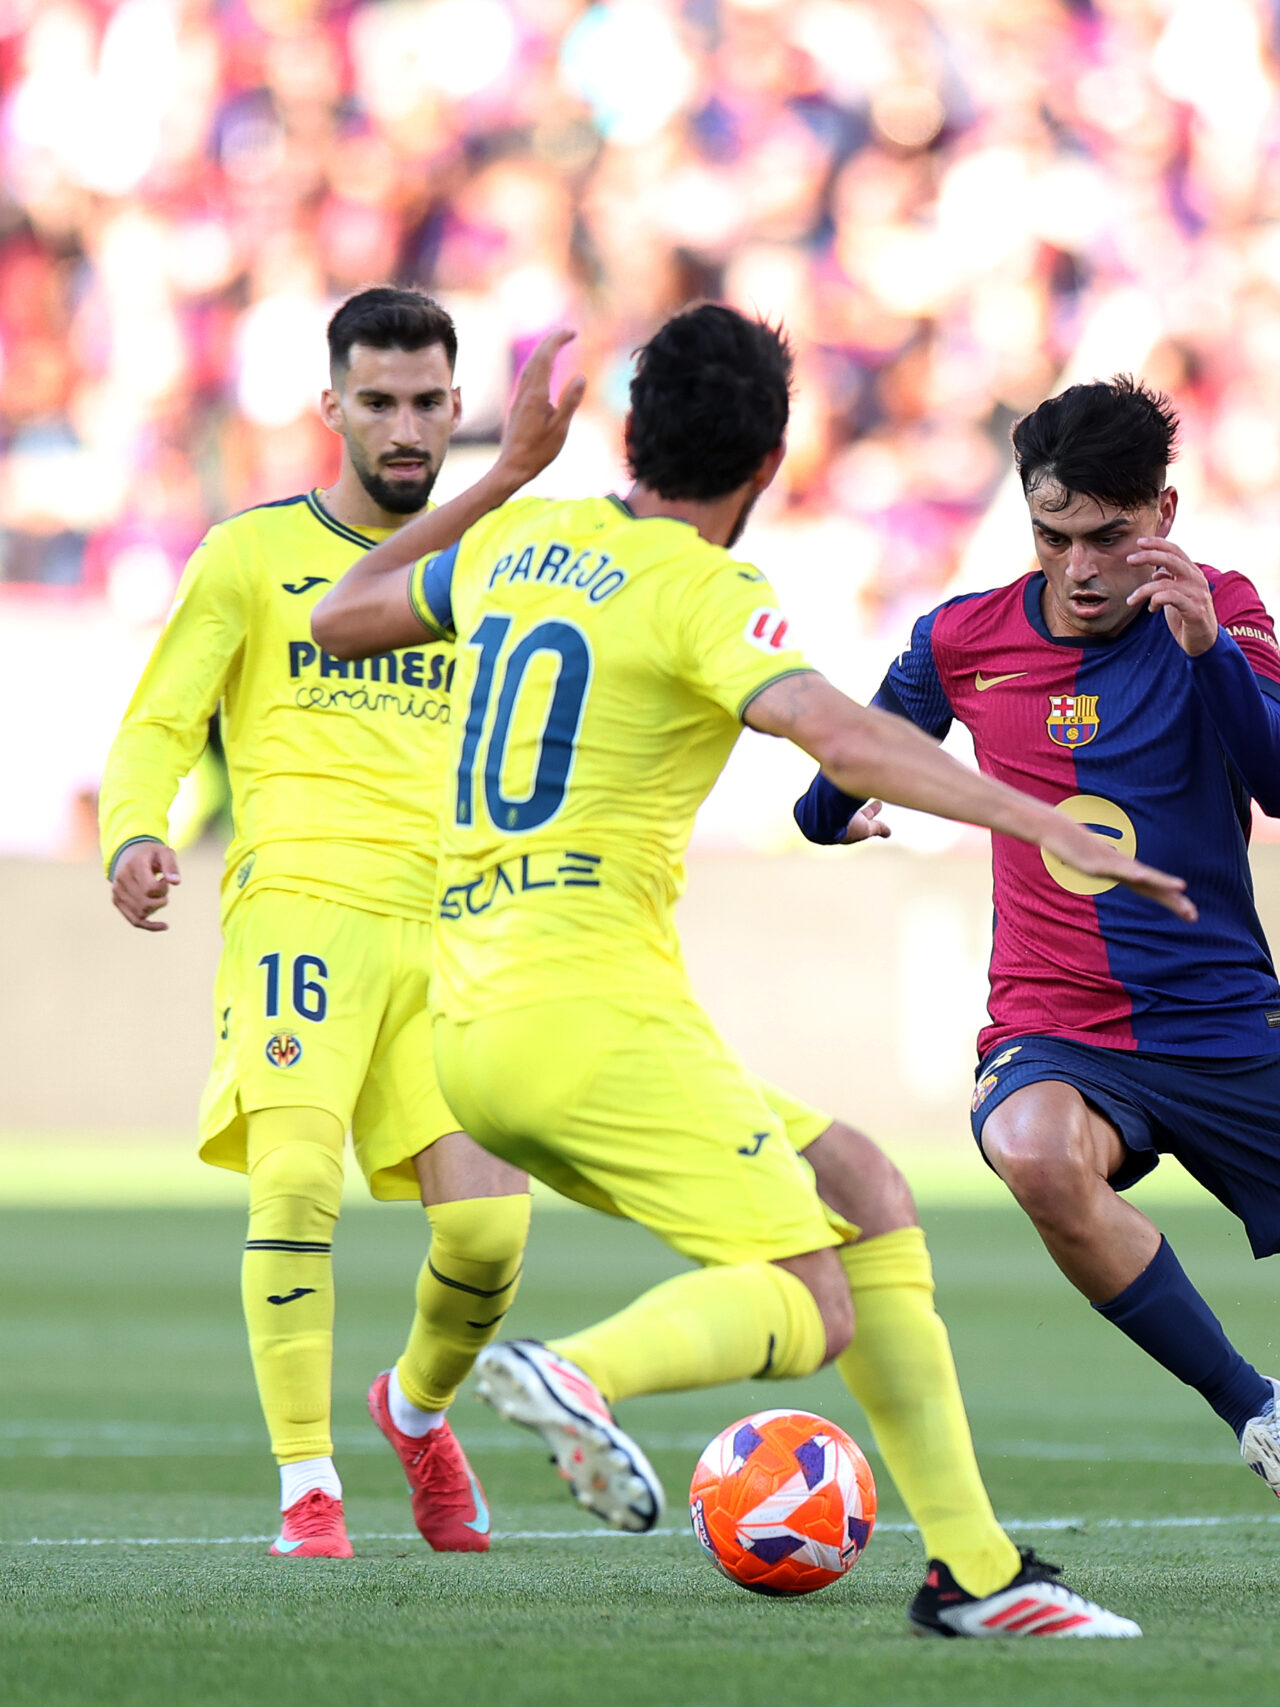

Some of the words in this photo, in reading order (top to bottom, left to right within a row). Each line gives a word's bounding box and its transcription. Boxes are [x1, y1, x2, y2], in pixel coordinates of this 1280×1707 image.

[288, 641, 457, 693] PAMES
[454, 615, 592, 832] 10
[257, 952, 329, 1023] 16
